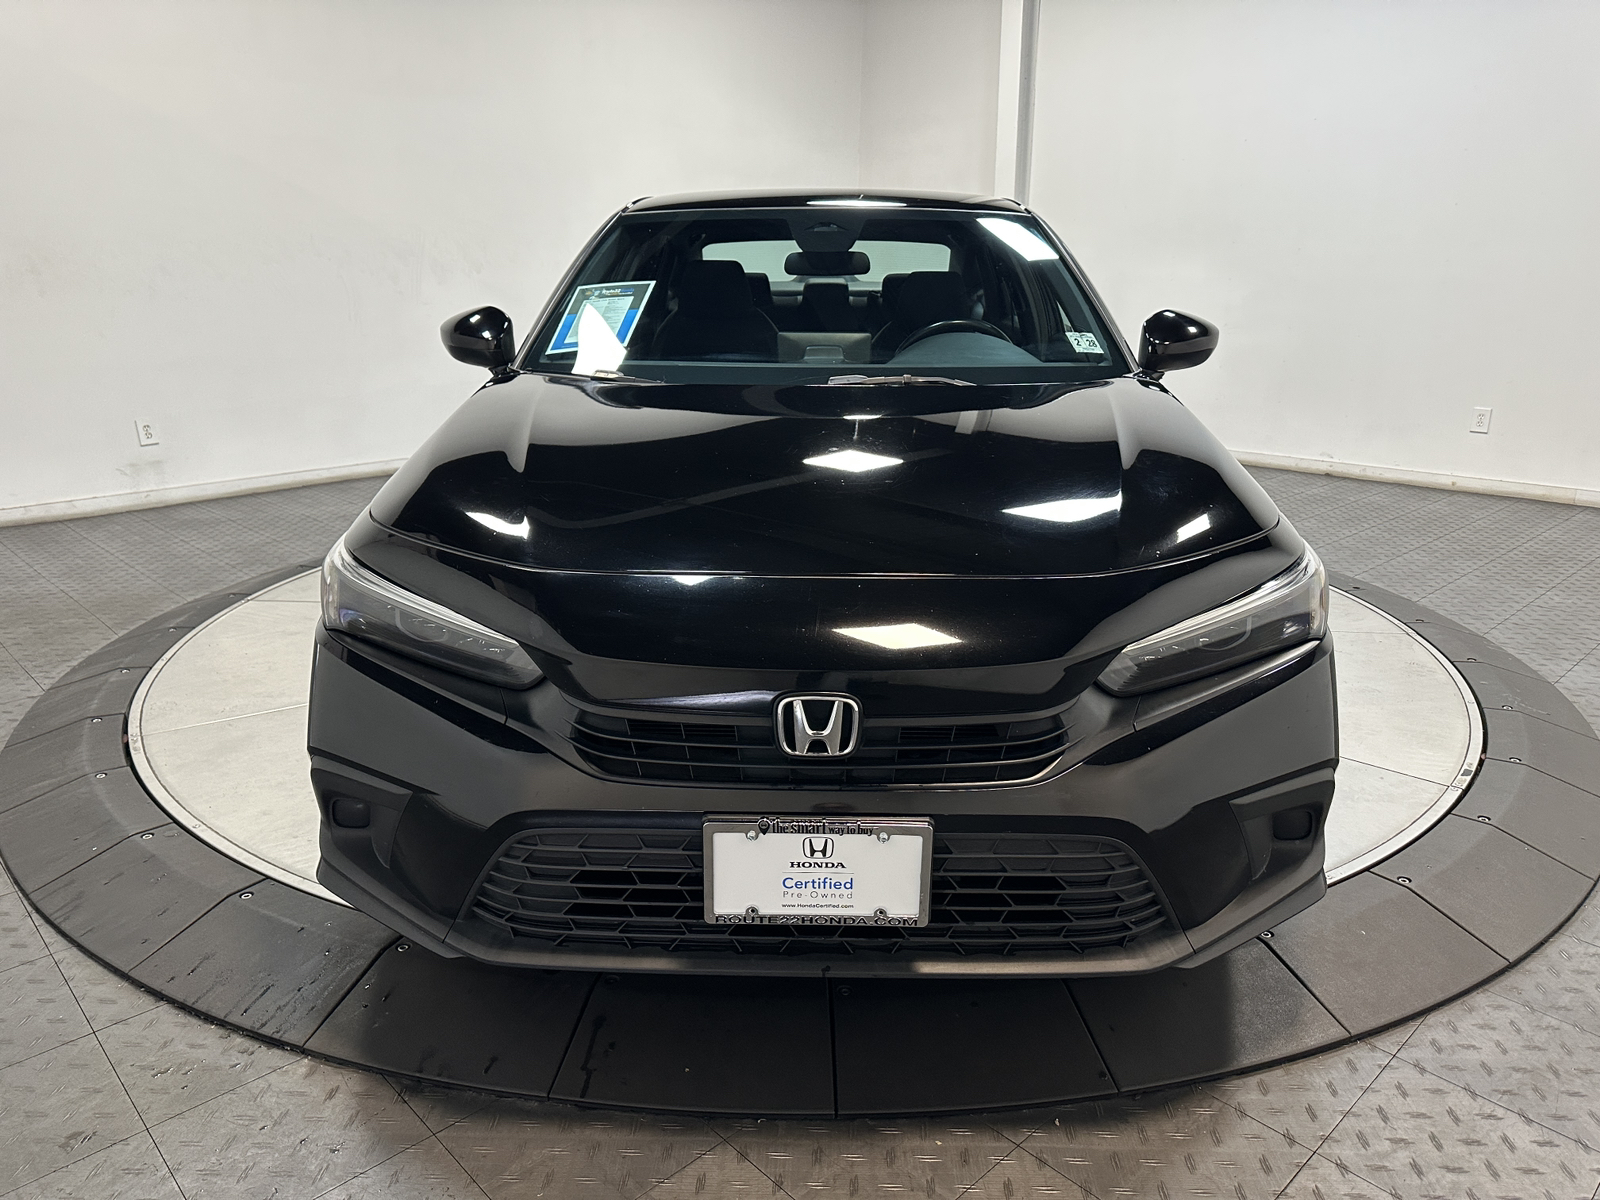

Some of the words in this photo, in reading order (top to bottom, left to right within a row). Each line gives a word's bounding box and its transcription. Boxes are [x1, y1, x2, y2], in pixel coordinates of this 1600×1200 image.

[1074, 338, 1082, 346] 2
[1086, 339, 1097, 347] 28
[772, 817, 789, 834] the
[791, 818, 826, 834] smart
[828, 826, 845, 836] way
[847, 824, 857, 835] to
[857, 820, 874, 836] buy
[789, 861, 847, 869] HONDA
[782, 877, 854, 890] Certified
[782, 890, 853, 900] Pre-Owned
[715, 915, 918, 927] ROUTE22HONDA.COM
